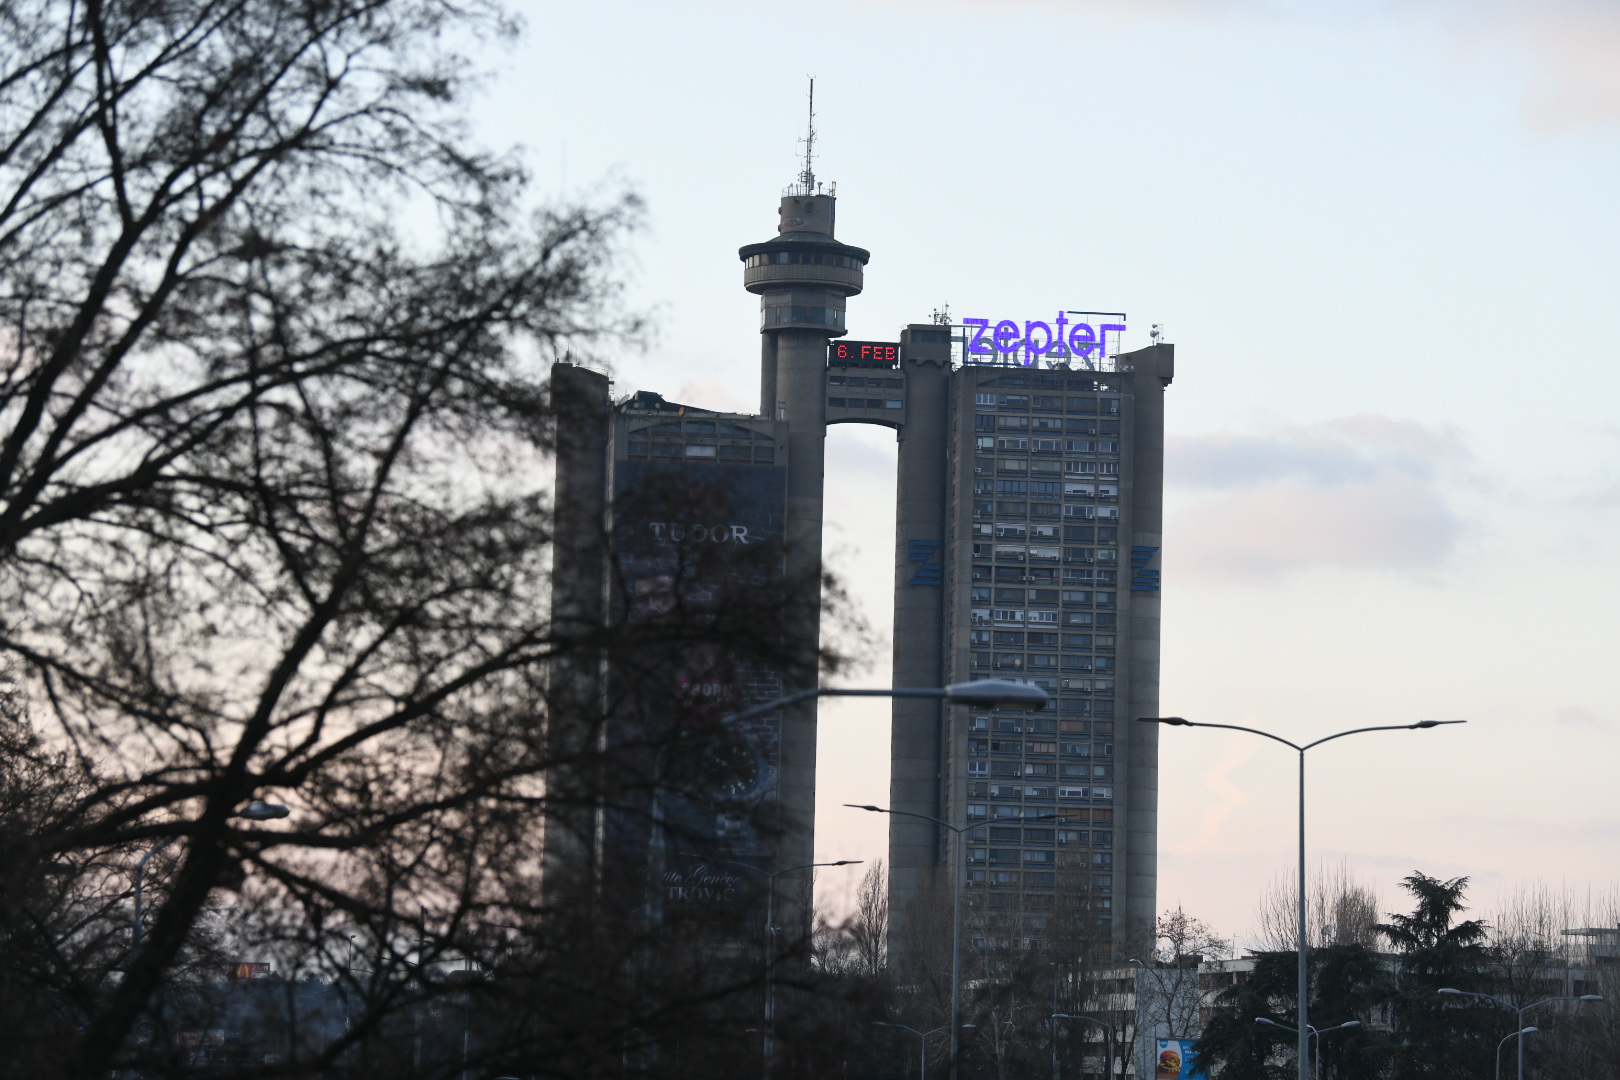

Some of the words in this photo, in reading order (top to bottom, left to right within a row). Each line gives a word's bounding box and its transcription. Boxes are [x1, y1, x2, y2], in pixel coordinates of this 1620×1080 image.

[963, 310, 1126, 366] zepter
[837, 344, 854, 358] 6.
[861, 345, 896, 360] FEB
[649, 522, 749, 544] TUDOR
